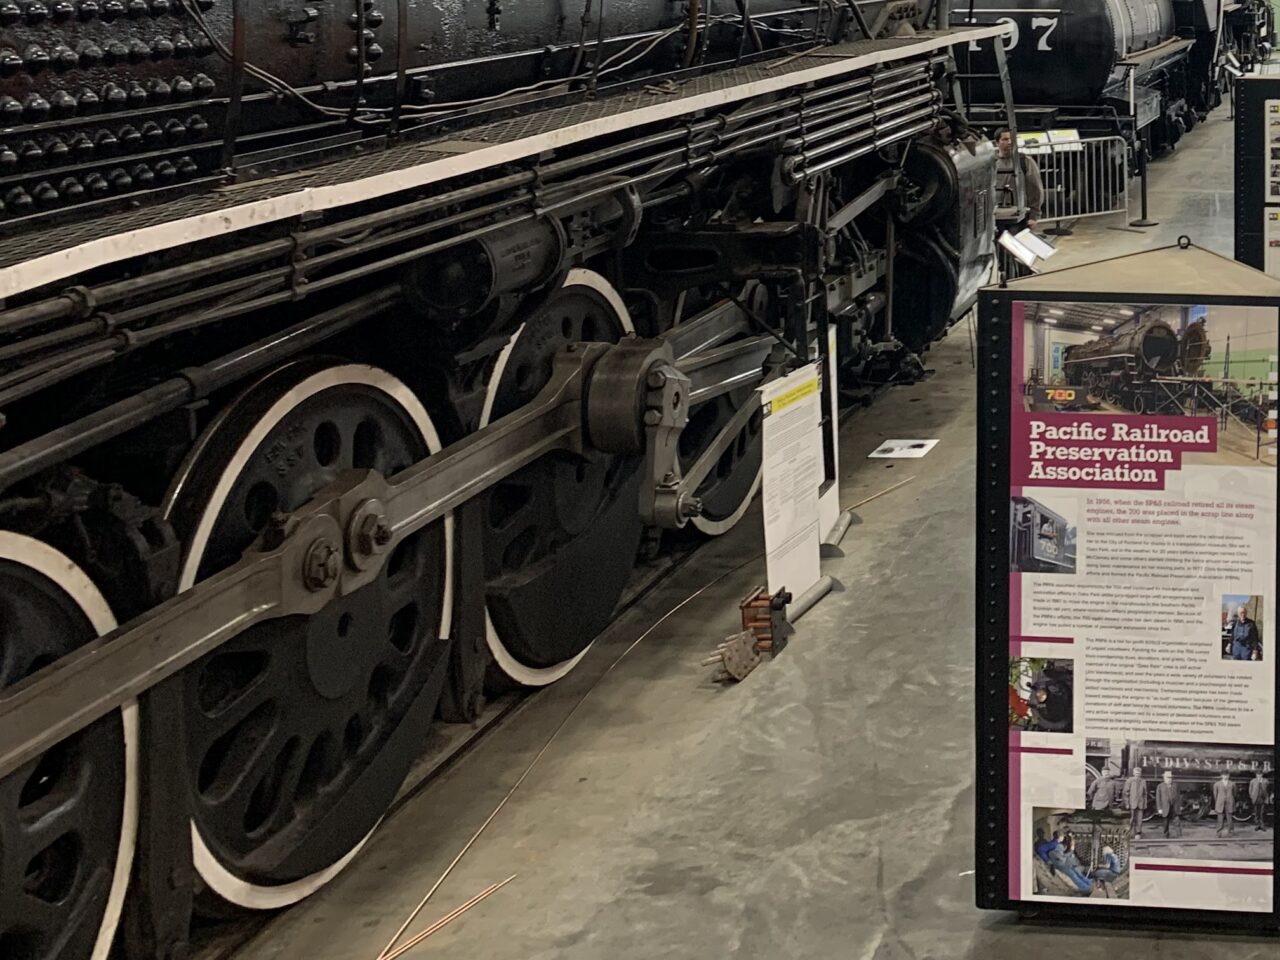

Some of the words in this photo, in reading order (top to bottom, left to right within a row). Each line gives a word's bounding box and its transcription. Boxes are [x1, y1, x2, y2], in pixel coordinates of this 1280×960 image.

[1030, 421, 1107, 441] Pacific
[1112, 423, 1210, 444] Railroad
[1030, 441, 1173, 462] Preservation
[1028, 462, 1158, 482] Association
